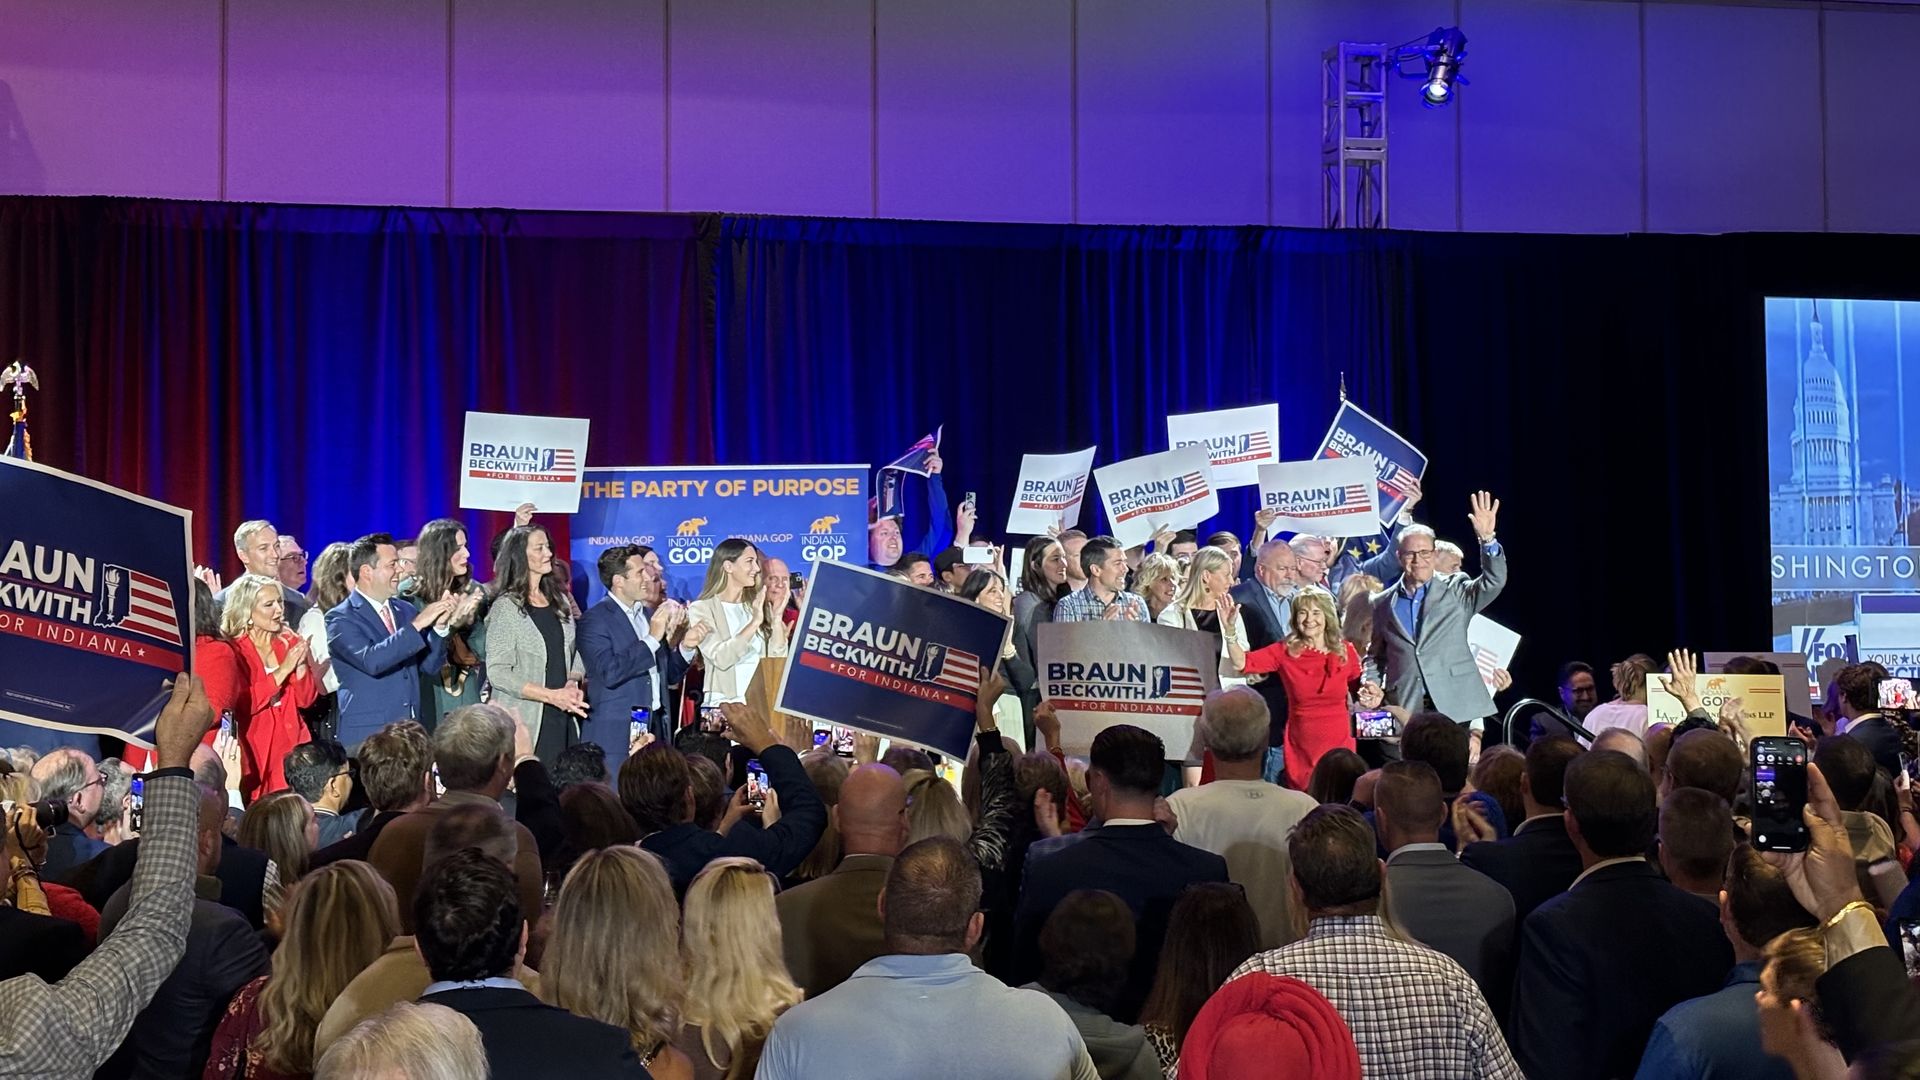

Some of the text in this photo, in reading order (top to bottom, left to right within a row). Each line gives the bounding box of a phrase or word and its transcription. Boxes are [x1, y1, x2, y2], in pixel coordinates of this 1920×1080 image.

[470, 443, 539, 461] BRAUN
[469, 459, 538, 472] BECKWITH
[515, 474, 555, 482] INDIANA
[1023, 478, 1073, 493] BRAUN
[582, 478, 859, 499] THE PARTY OF PURPOSE
[1108, 480, 1170, 505] BRAUN
[1266, 488, 1330, 505] BRAUN
[1113, 493, 1172, 515] BECKWITH
[1155, 498, 1191, 511] INDIANA
[1267, 502, 1331, 512] ECKWITH
[668, 538, 714, 547] INDIANA
[801, 535, 847, 545] INDIANA
[669, 547, 714, 564] GOP
[801, 545, 847, 561] GOP
[1772, 555, 1920, 578] SHINGTO
[37, 623, 132, 657] INDIANA
[808, 607, 921, 660] BRAUN
[803, 633, 915, 679] BECKWITH
[1867, 654, 1898, 665] YOUR
[1048, 662, 1146, 682] BRAUN
[837, 663, 940, 700] FOR INDIANA
[1048, 684, 1146, 700] BECKWITH
[1081, 702, 1174, 713] FOR INDIANA
[1759, 711, 1774, 719] LLP
